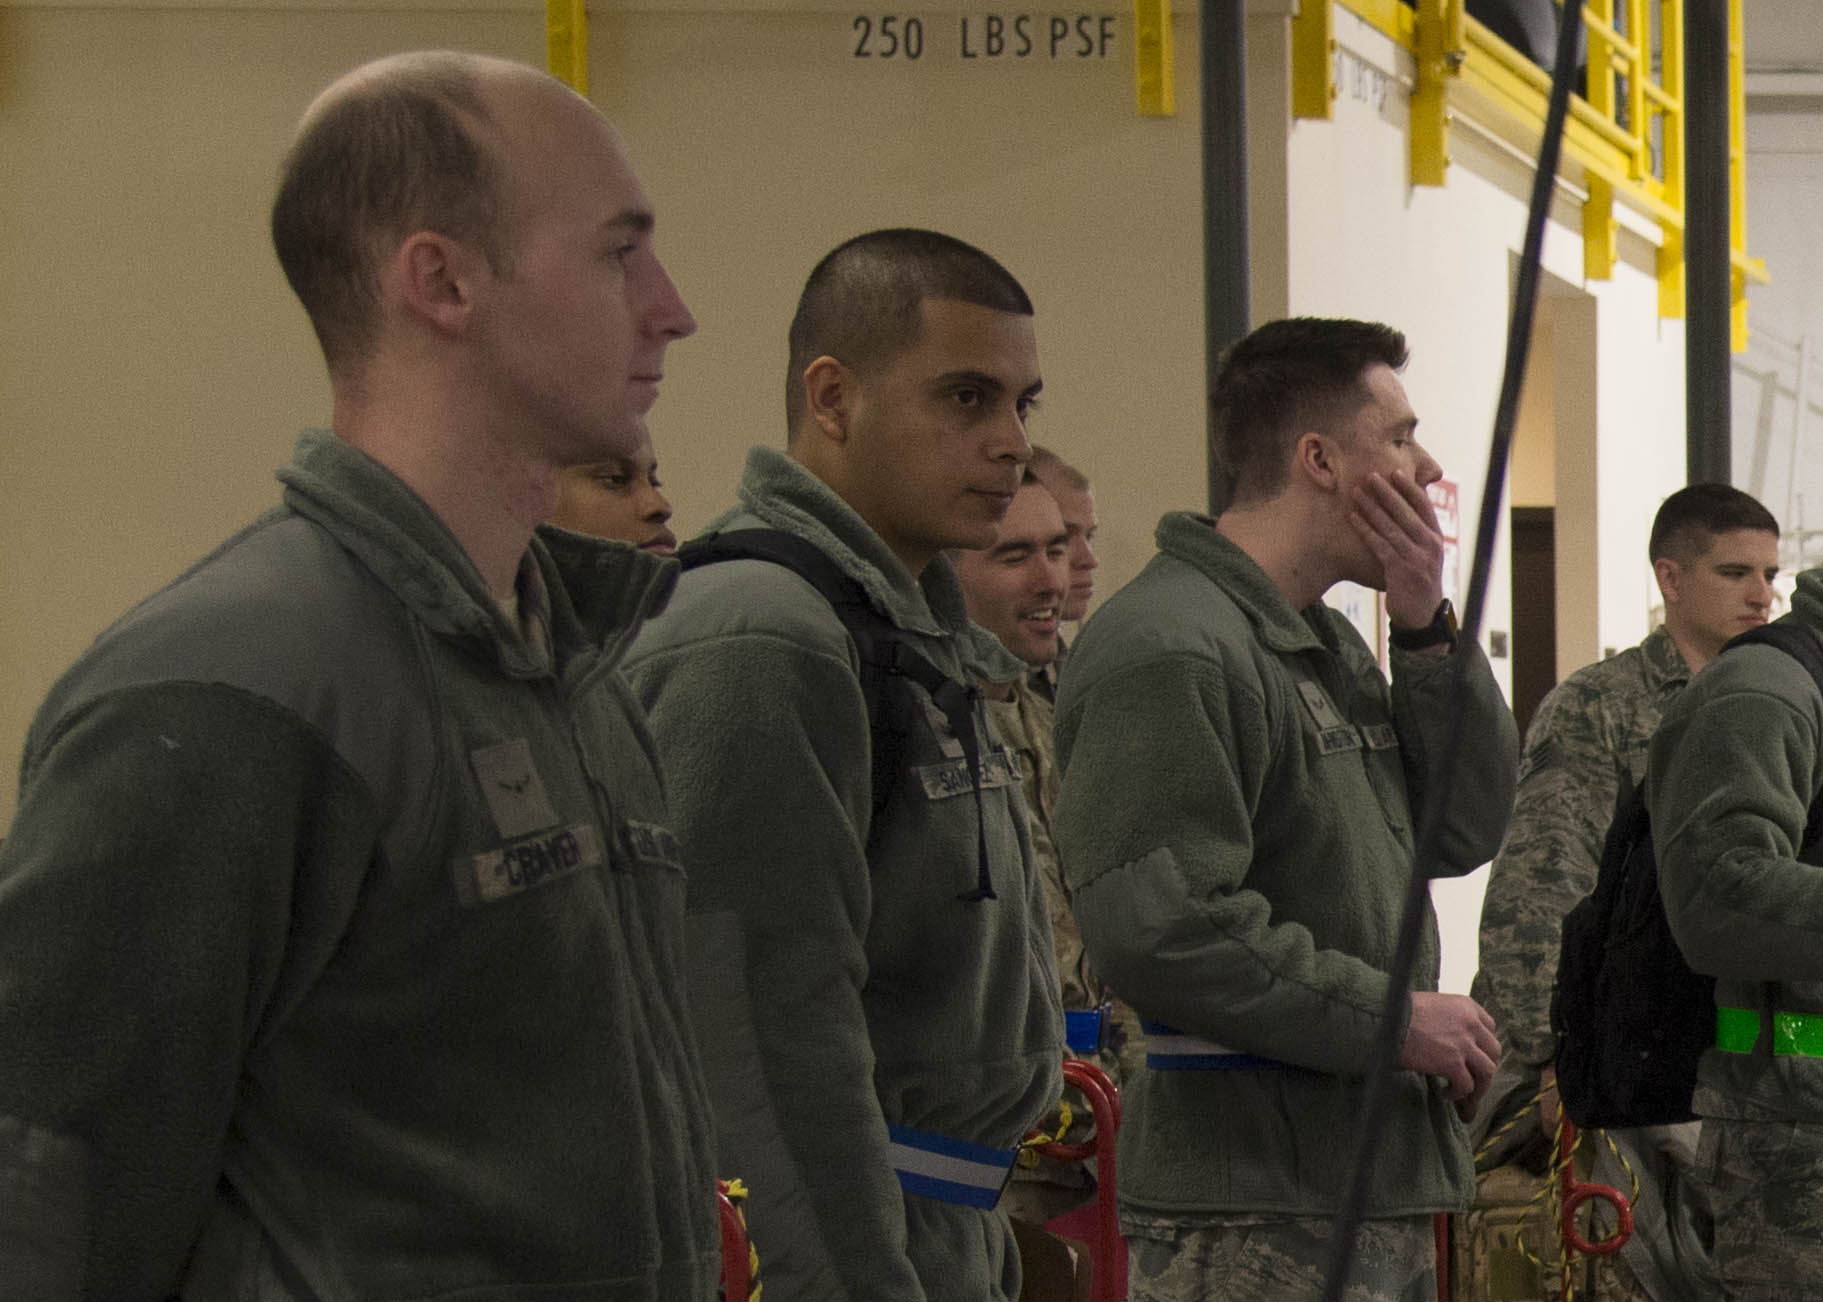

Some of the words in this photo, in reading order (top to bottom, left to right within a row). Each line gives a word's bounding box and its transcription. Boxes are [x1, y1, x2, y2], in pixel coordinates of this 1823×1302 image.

[853, 16, 923, 59] 250
[961, 16, 1032, 58] LBS
[1050, 16, 1115, 57] PSF
